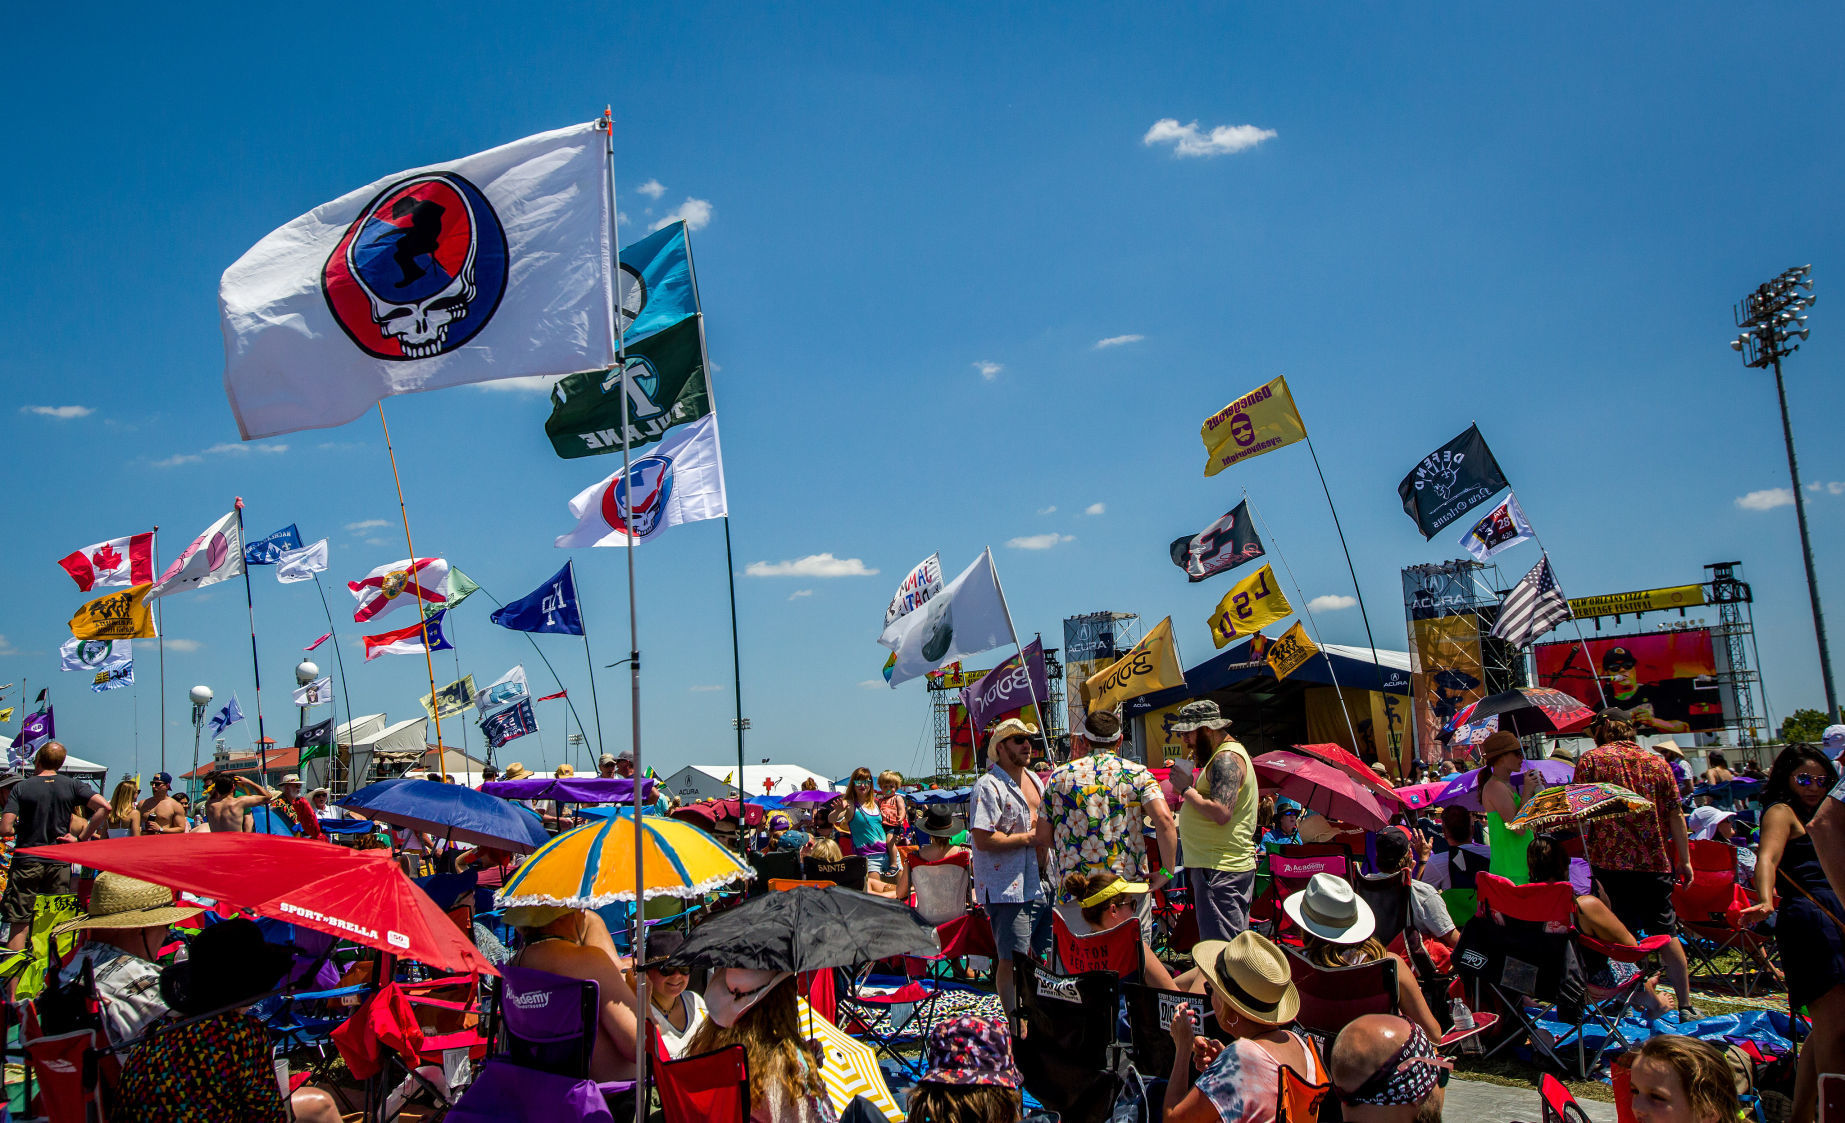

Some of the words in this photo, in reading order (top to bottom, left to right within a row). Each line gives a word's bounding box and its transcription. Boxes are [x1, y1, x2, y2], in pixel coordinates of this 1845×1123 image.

[1497, 516, 1510, 529] 28
[1412, 594, 1466, 609] ACURA
[1572, 599, 1587, 608] NEW
[1589, 594, 1623, 606] ORLEANS
[1625, 592, 1641, 602] JAZZ
[1642, 591, 1650, 599] &
[1573, 605, 1613, 617] HERITAGE
[1615, 600, 1653, 614] FESTIVAL
[1068, 640, 1107, 652] ACURA
[1164, 746, 1181, 758] JAZZ
[818, 863, 846, 873] SAINTS
[1293, 862, 1325, 871] Academy
